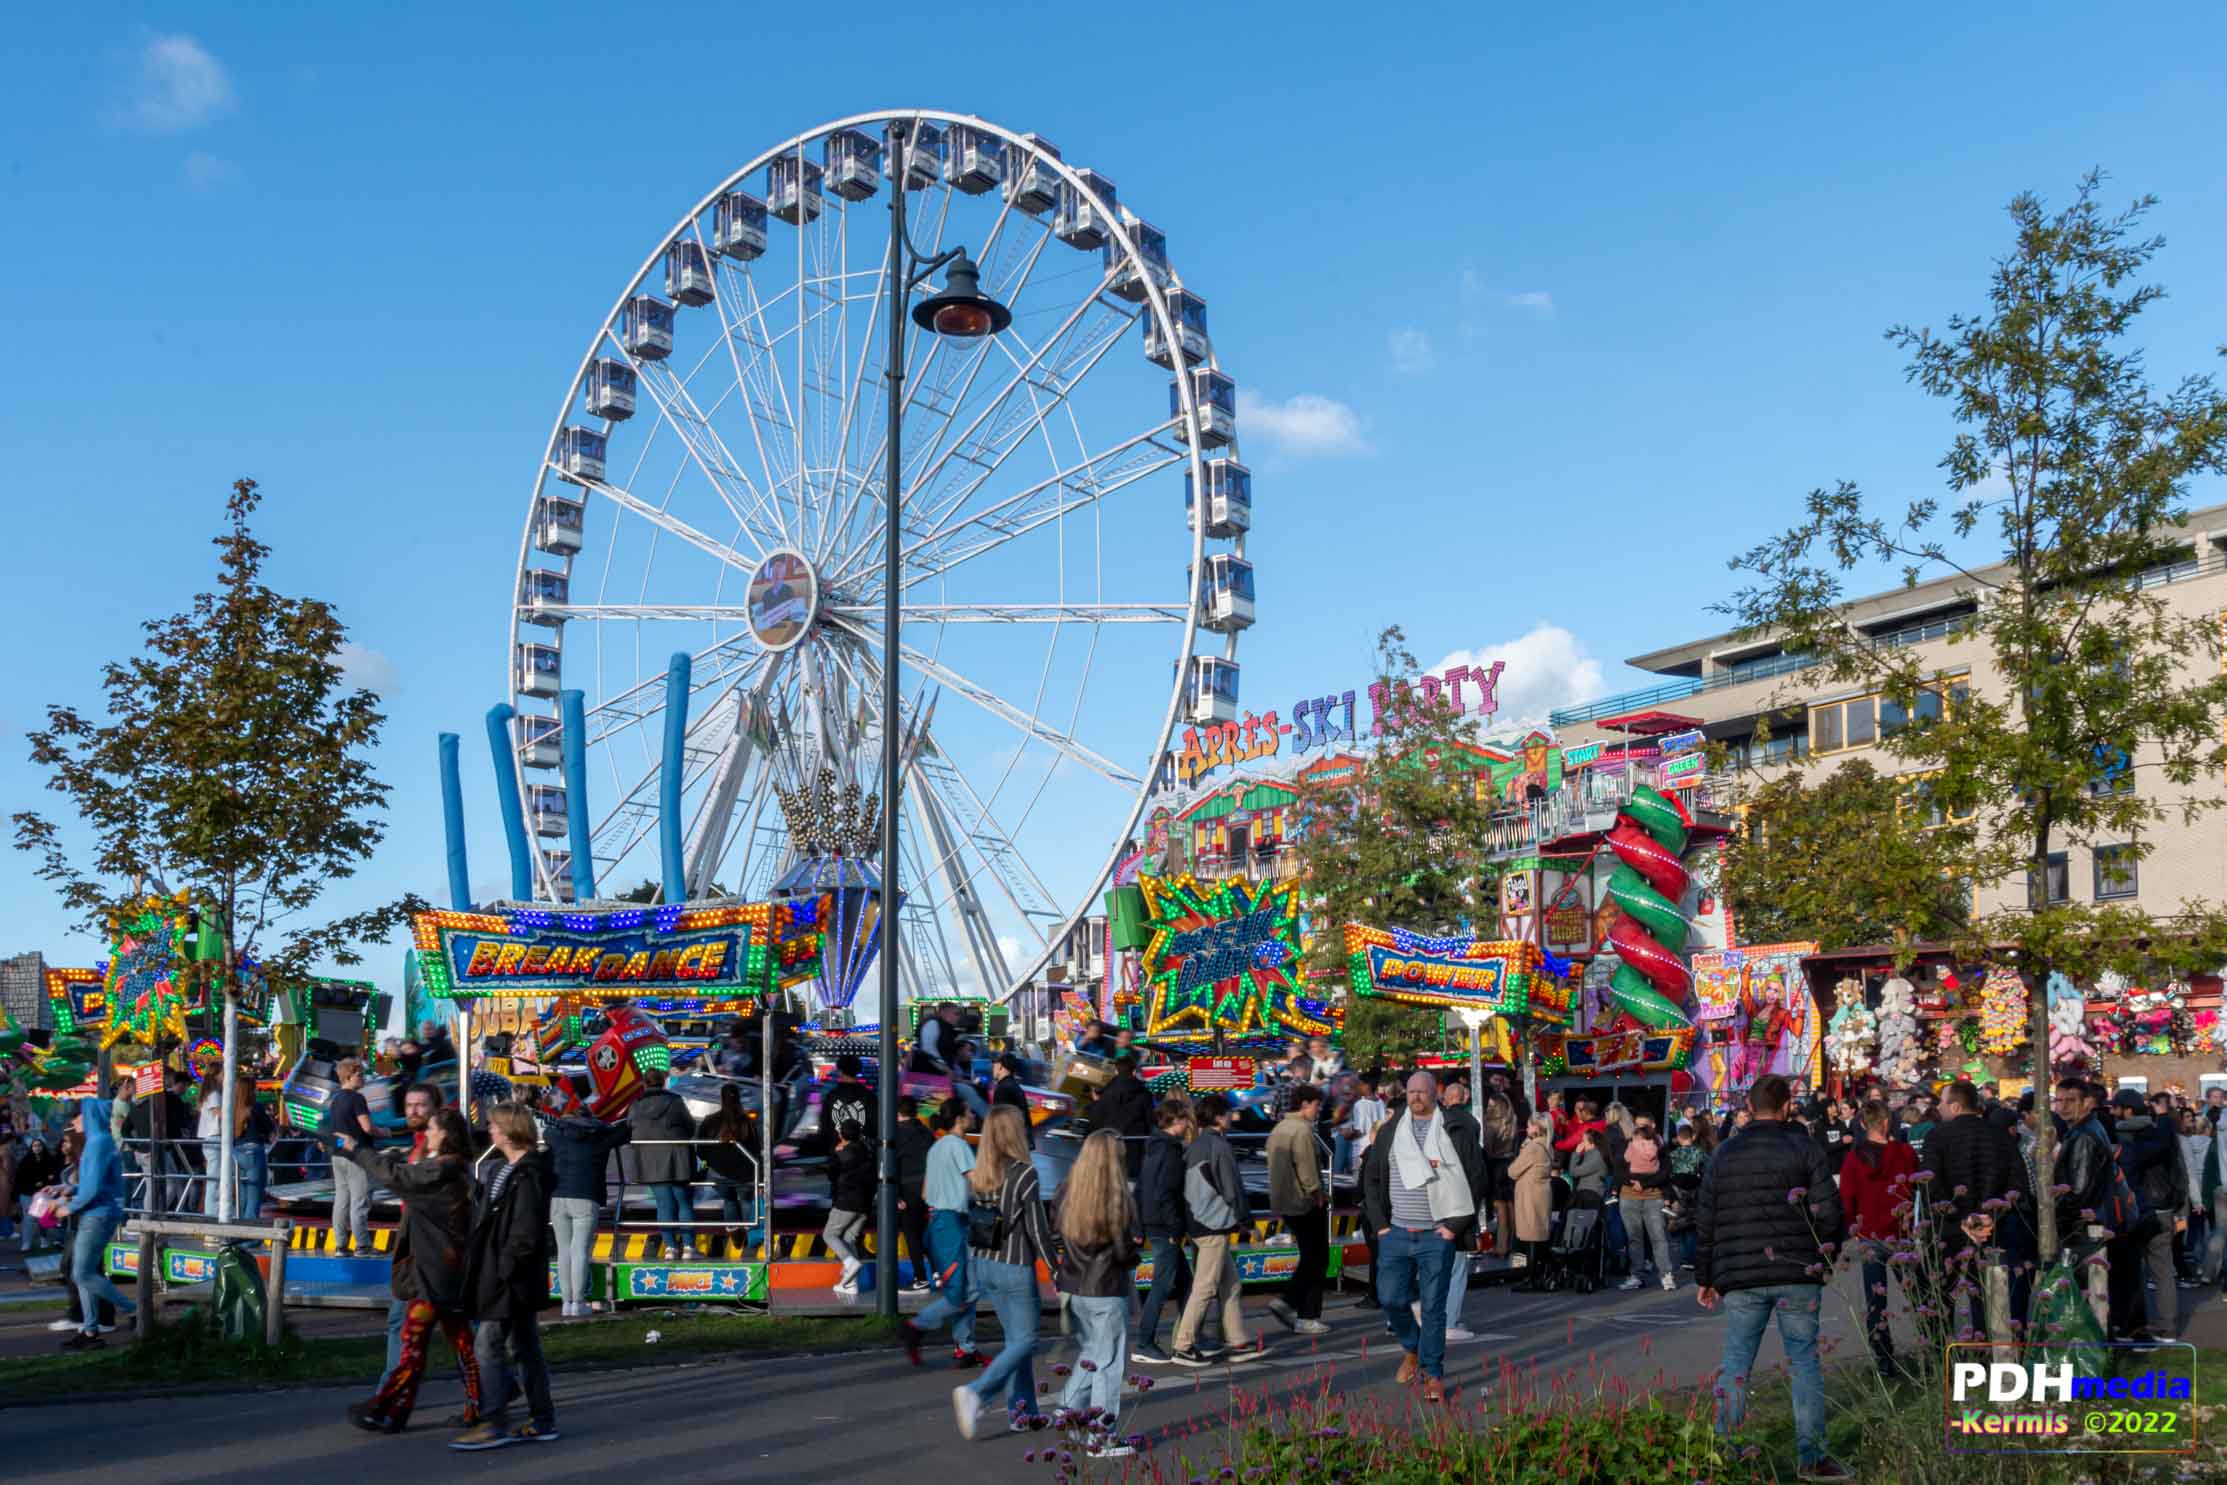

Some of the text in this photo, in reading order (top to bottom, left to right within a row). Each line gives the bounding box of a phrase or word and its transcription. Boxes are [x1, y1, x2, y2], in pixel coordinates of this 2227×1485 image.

[1567, 744, 1599, 767] START
[1668, 757, 1700, 775] GREEN
[466, 940, 729, 980] BREAK DANCE
[1380, 957, 1497, 993] POWER
